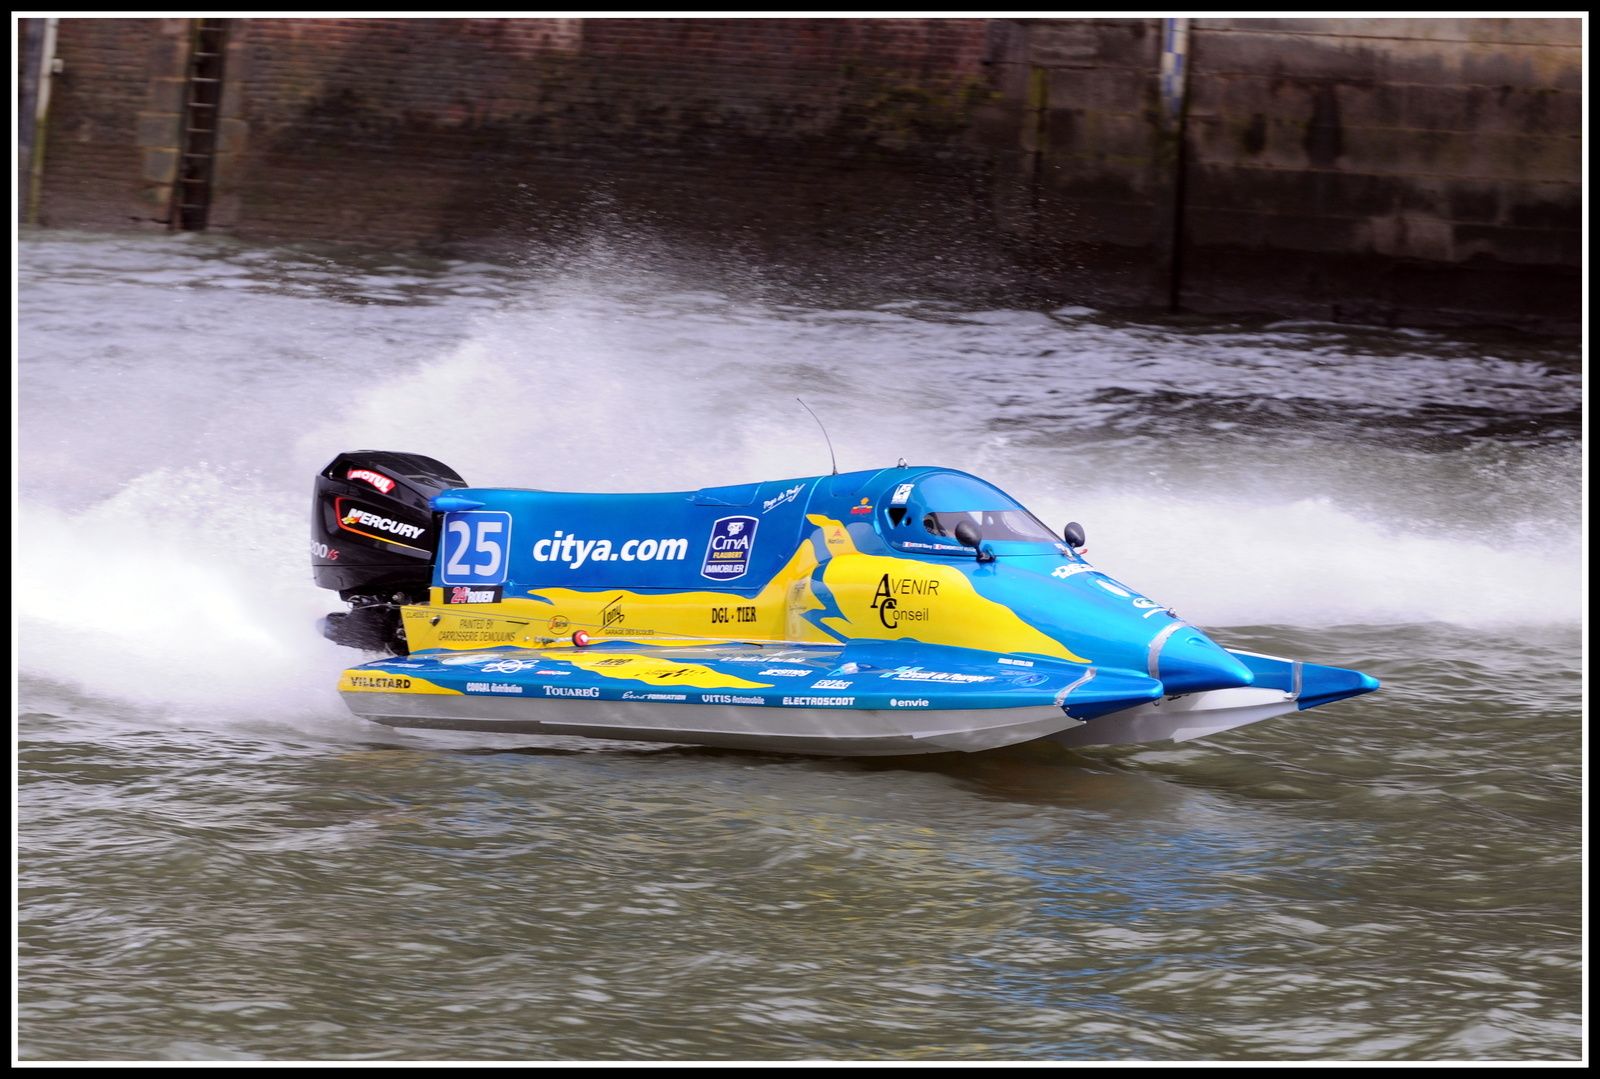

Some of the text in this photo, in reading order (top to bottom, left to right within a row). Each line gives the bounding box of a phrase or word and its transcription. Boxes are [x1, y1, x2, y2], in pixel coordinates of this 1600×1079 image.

[350, 470, 392, 493] MOTUL
[346, 508, 425, 539] MERCURY
[447, 520, 503, 576] 25
[533, 530, 688, 569] citya.com
[713, 551, 744, 559] FLAUBERT
[705, 564, 745, 574] IMMOBILIER
[870, 573, 940, 610] AVENIR
[711, 607, 729, 623] DGL
[737, 607, 757, 623] TIER
[879, 598, 929, 629] Conseil
[460, 619, 494, 630] PAINTED BY
[439, 631, 516, 642] CARROSSERIE DEMOULINS
[351, 676, 411, 688] VILLETARD
[732, 696, 764, 704] Automobile
[783, 696, 855, 706] ELECTROSCOOT
[897, 698, 929, 707] envie
